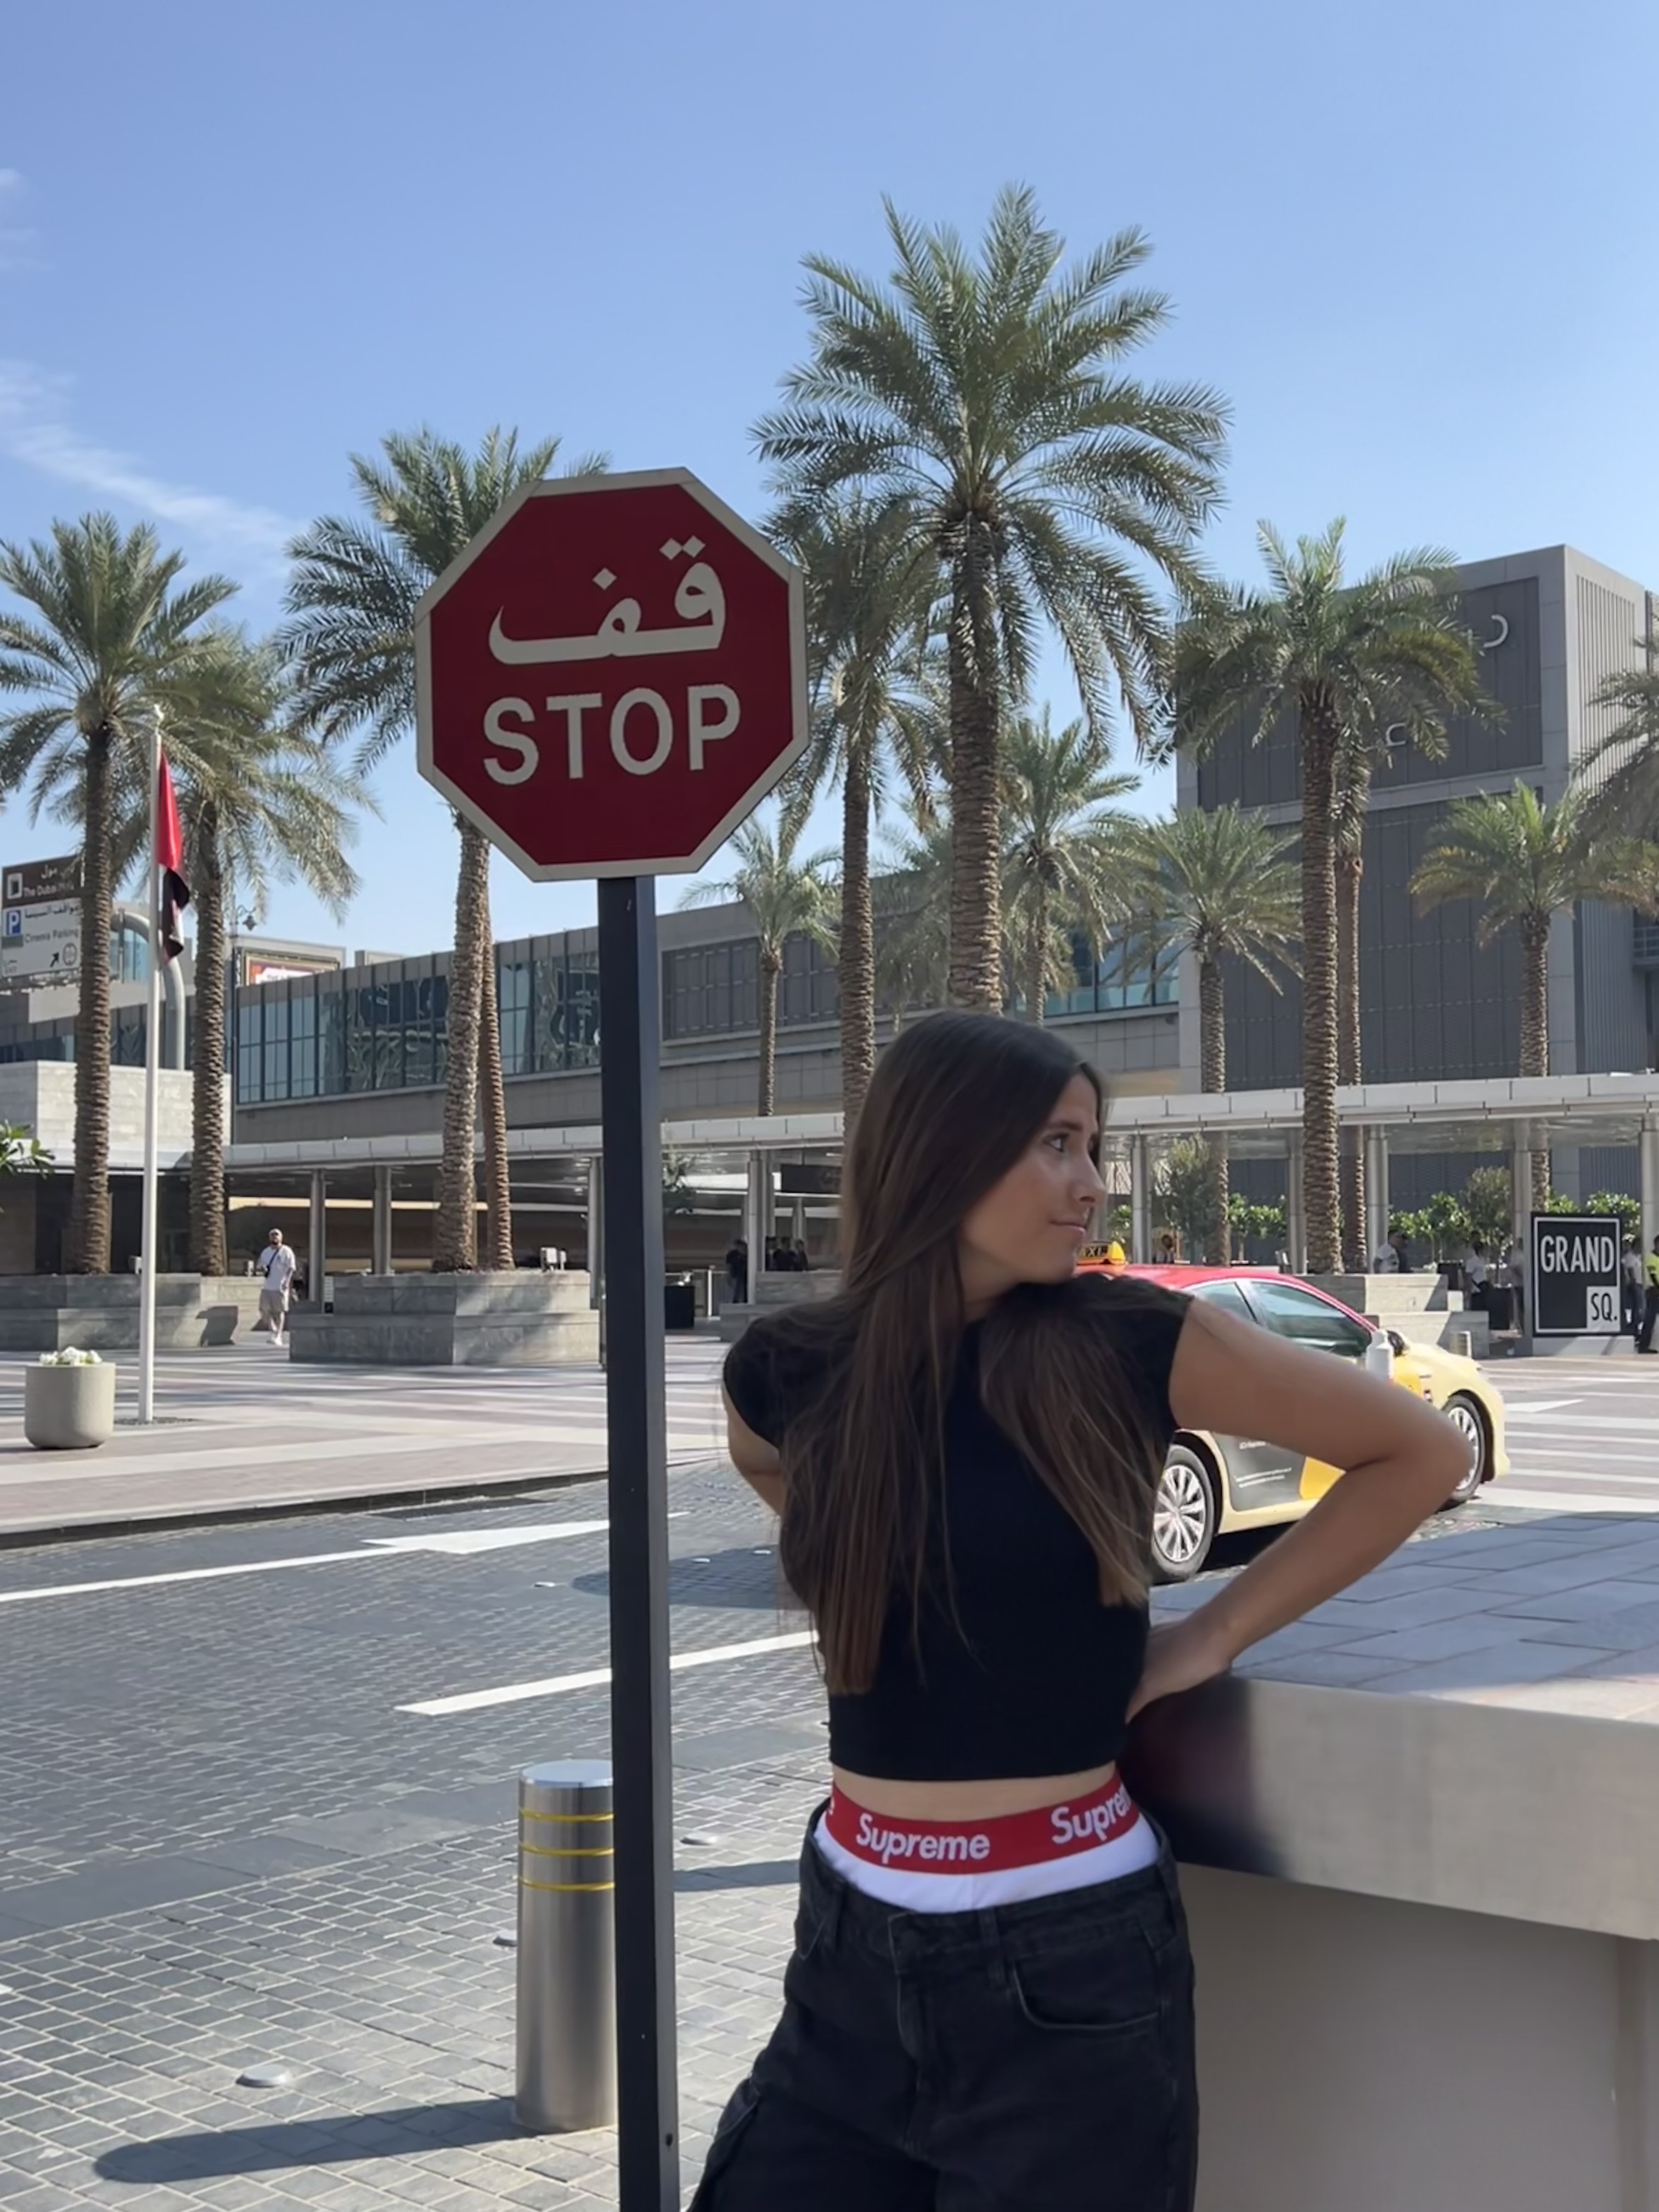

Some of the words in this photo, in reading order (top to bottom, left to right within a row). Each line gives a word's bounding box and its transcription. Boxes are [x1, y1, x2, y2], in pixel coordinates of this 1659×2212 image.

[488, 535, 726, 665] قف
[483, 684, 741, 785] STOP
[9, 911, 19, 934] P
[53, 929, 78, 939] Parking
[1540, 1235, 1615, 1273] GRAND
[1590, 1293, 1618, 1322] SQ.
[856, 1813, 990, 1864] Supreme
